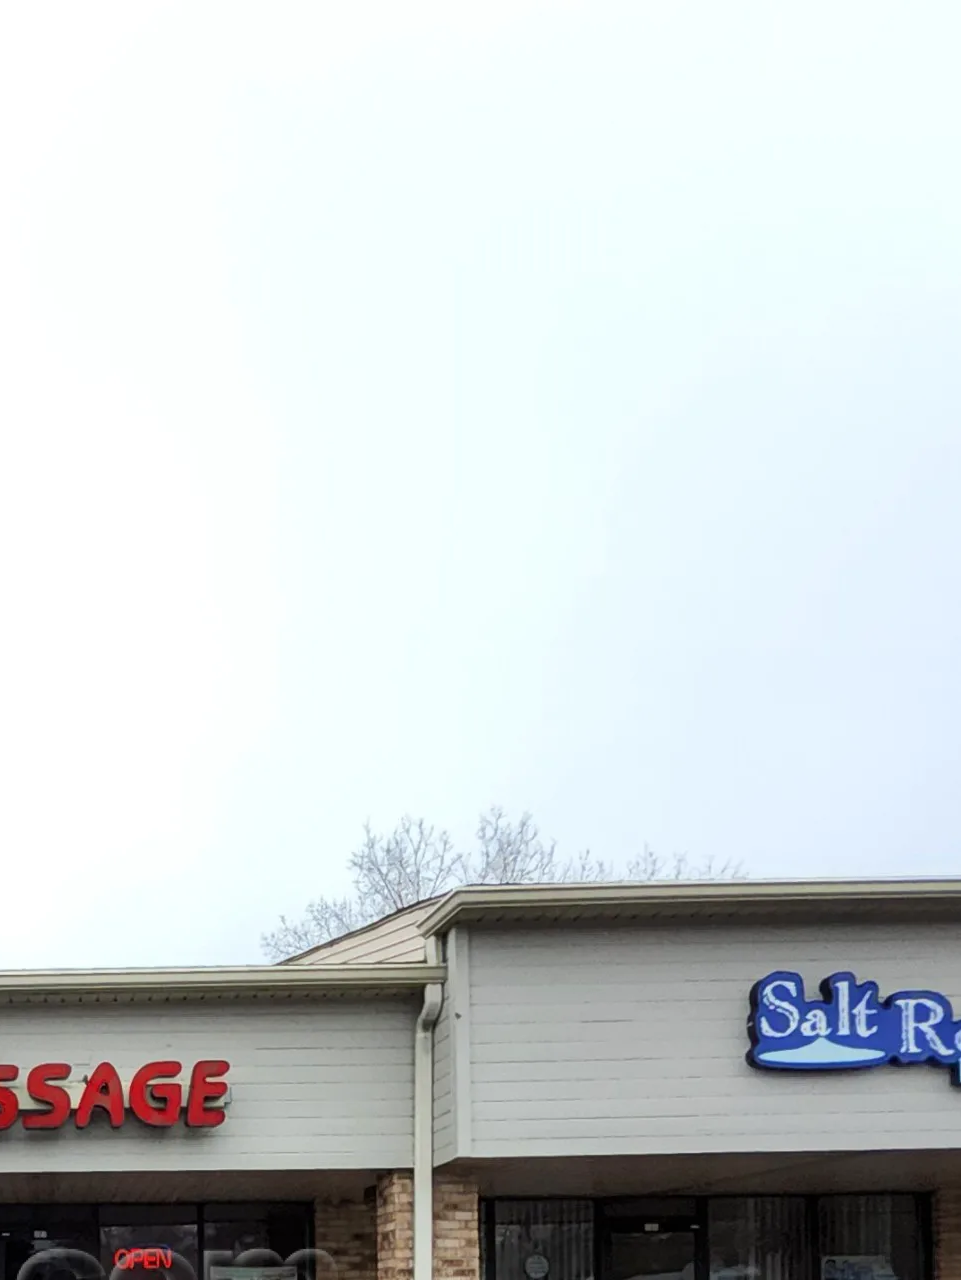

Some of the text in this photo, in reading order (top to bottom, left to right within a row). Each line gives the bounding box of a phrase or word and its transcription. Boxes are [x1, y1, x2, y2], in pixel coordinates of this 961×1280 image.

[760, 980, 961, 1056] Salt R
[113, 1248, 172, 1270] OPEN
